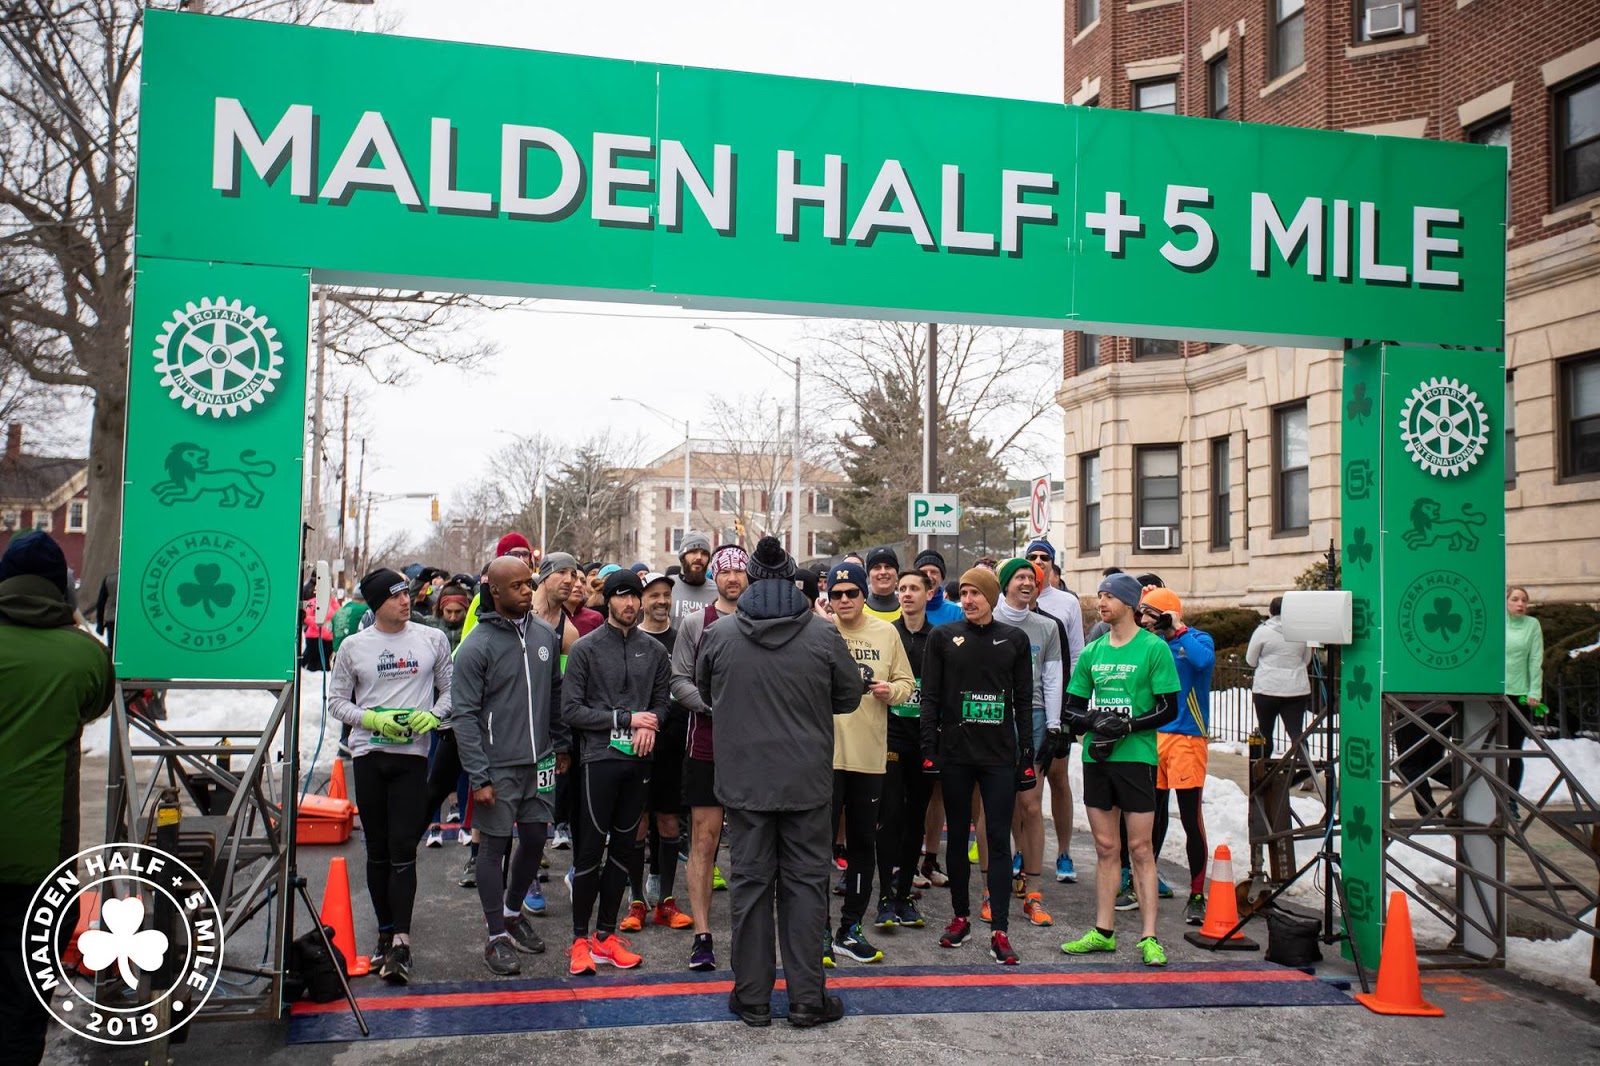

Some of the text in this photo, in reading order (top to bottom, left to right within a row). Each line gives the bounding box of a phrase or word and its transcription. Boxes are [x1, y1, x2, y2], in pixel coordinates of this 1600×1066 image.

[212, 97, 1463, 291] MALDEN HALF + 5 MILE
[194, 309, 248, 325] ROTARY
[173, 373, 264, 405] INTERNATIONAL
[1425, 387, 1463, 400] ROTARY
[1413, 440, 1476, 466] INTERNATIONAL
[914, 499, 952, 528] PARKING
[184, 535, 236, 550] HALF
[247, 561, 260, 572] 5
[146, 545, 180, 620] MALDEN
[836, 570, 849, 580] M
[1425, 574, 1461, 586] HALF
[247, 577, 266, 620] MILE
[682, 600, 703, 610] RUN
[1469, 594, 1479, 604] 5
[1402, 583, 1424, 643] MALDEN
[1470, 608, 1483, 644] MILE
[180, 632, 227, 647] 2019
[377, 658, 419, 671] IRONMAN
[1426, 653, 1459, 666] 2019
[1091, 664, 1138, 673] FLEET FEET
[964, 702, 1003, 719] 1345
